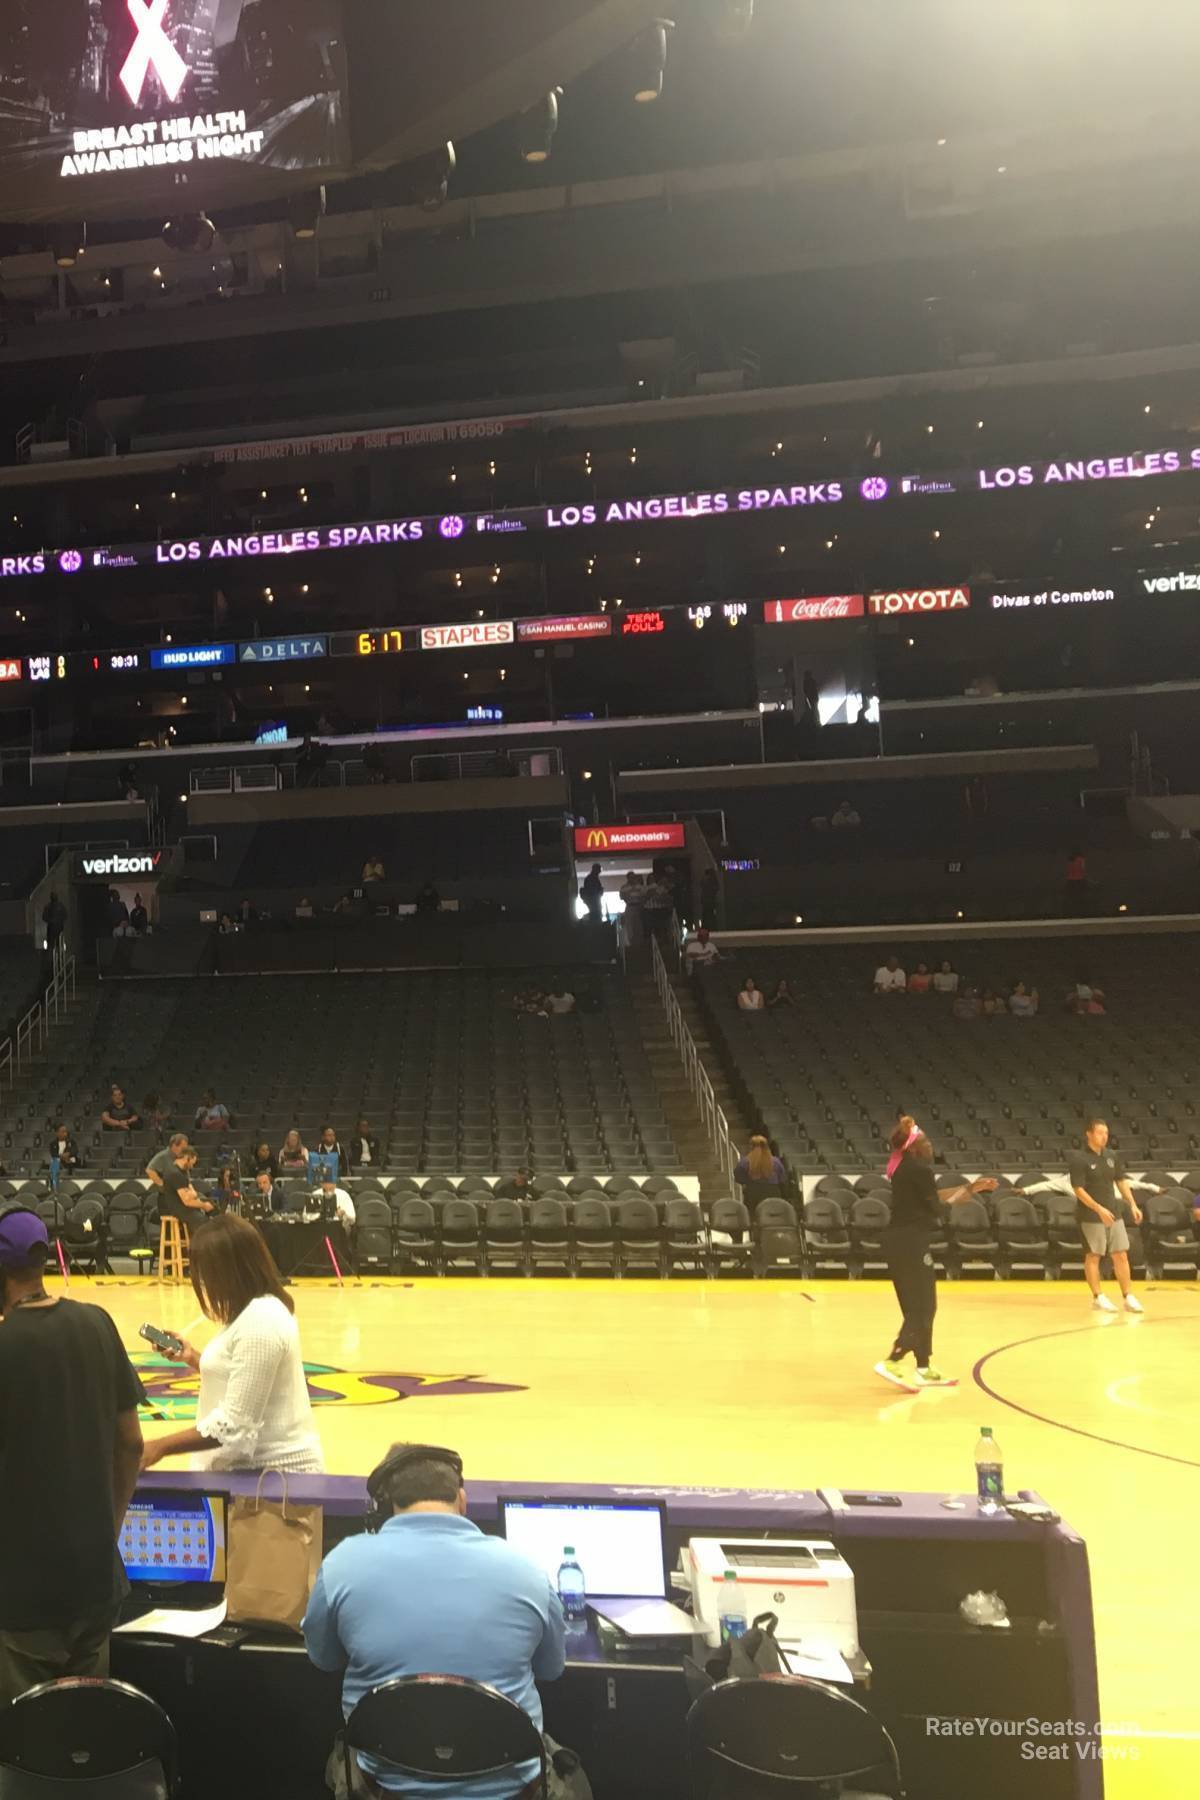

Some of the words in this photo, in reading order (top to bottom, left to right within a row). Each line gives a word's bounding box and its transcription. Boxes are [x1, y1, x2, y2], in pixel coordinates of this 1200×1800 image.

[73, 122, 157, 152] BREAST
[161, 110, 247, 141] HEALTH
[60, 140, 193, 177] AWARENESS
[197, 130, 265, 160] NIGHT
[459, 422, 504, 439] 69050
[979, 466, 1033, 489] LOS
[1043, 451, 1180, 484] ANGELES
[547, 505, 596, 528] LOS
[605, 493, 729, 521] ANGELES
[738, 483, 843, 511] SPARKS
[156, 541, 201, 563] LOS
[209, 530, 320, 558] ANGELES
[328, 521, 423, 548] SPARKS
[1143, 571, 1200, 594] veriz
[870, 589, 969, 614] TOYOTA
[992, 592, 1030, 609] Divas
[1034, 592, 1048, 605] of
[627, 612, 660, 624] TEAM
[688, 606, 712, 619] LAS
[723, 603, 748, 617] MIN
[423, 624, 511, 648] STAPLES
[526, 625, 543, 635] SAN
[543, 624, 576, 633] MANUEL
[577, 621, 608, 631] CASINO
[624, 621, 664, 634] FOULS
[262, 641, 324, 658] DELTA
[358, 631, 402, 655] 6:17
[29, 657, 50, 669] MIN
[163, 653, 187, 664] BUD
[188, 650, 222, 662] LIGHT
[30, 668, 50, 680] LAS
[610, 831, 670, 843] McDonald's
[83, 855, 153, 874] verizon
